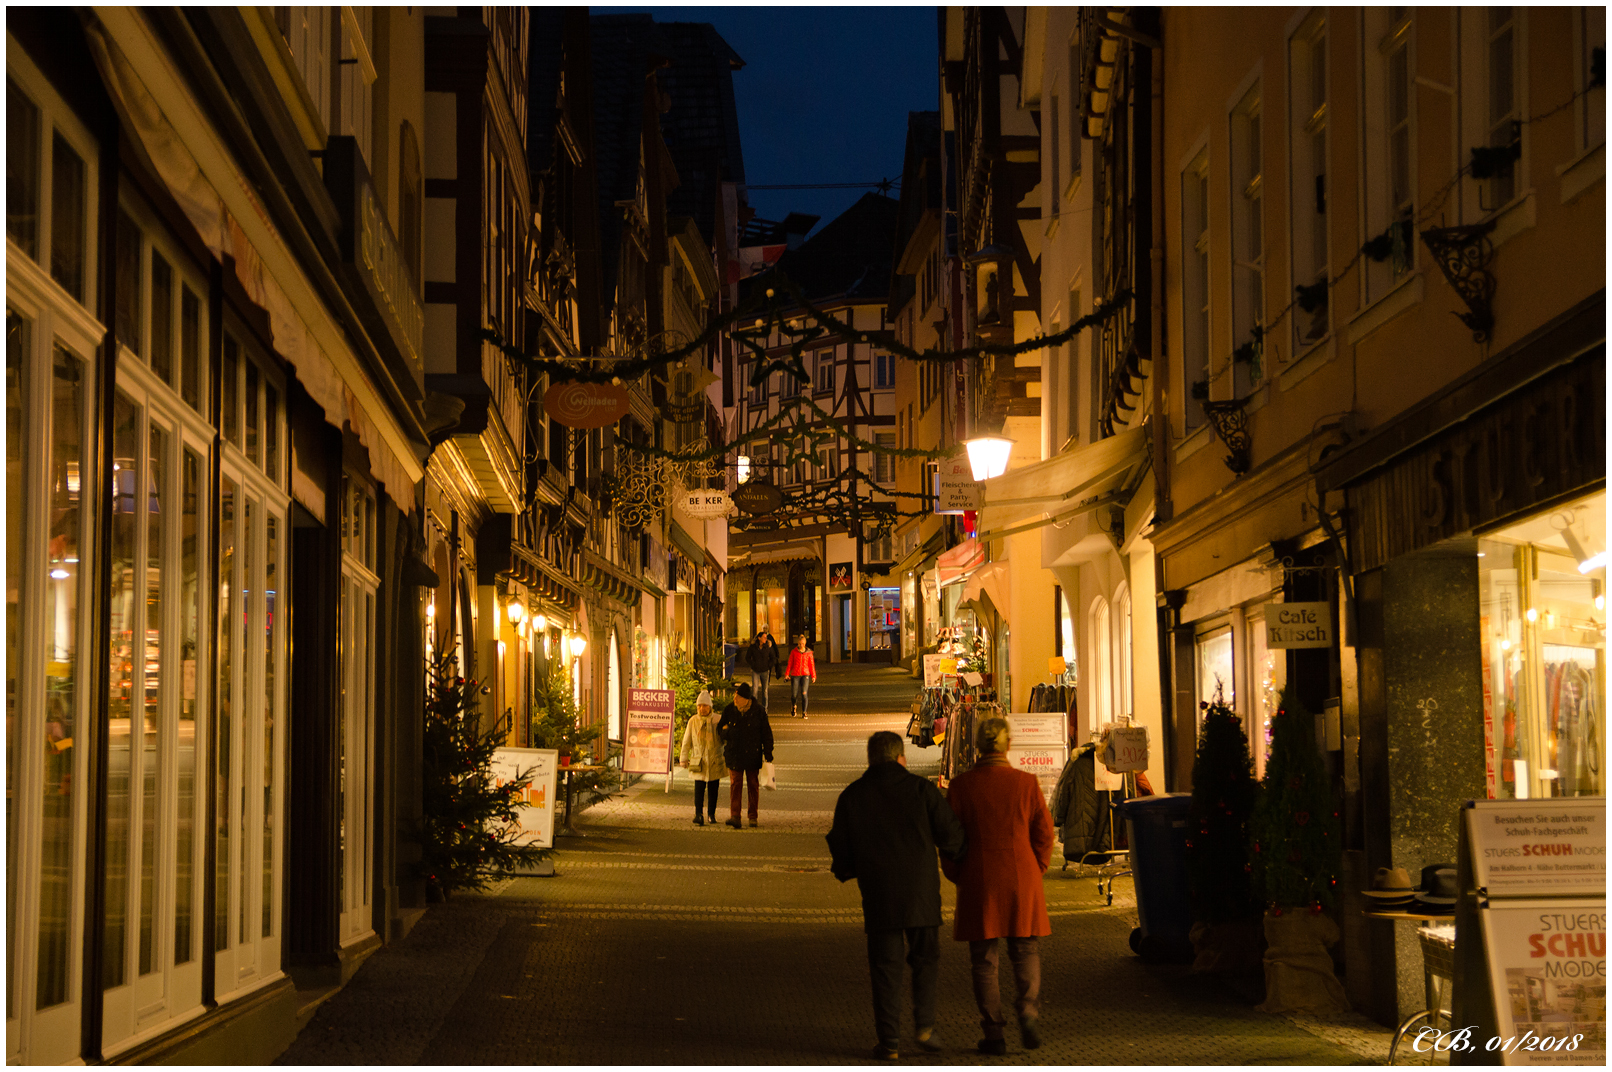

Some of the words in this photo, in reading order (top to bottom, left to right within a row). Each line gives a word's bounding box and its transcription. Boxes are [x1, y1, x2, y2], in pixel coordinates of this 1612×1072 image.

[570, 395, 618, 406] Weltladen
[1278, 609, 1317, 624] Café
[632, 691, 670, 702] BECKER
[1019, 757, 1054, 766] SCHUH
[1494, 814, 1535, 825] Besuchen
[1535, 814, 1549, 824] Sie
[1550, 813, 1570, 823] auch
[1571, 814, 1596, 823] unser
[1505, 825, 1588, 837] Schuh-Fachgeschäft
[1484, 847, 1521, 858] STUERS
[1522, 843, 1573, 857] SCHUH
[1574, 846, 1606, 856] MODE
[1529, 1054, 1554, 1062] Herren-
